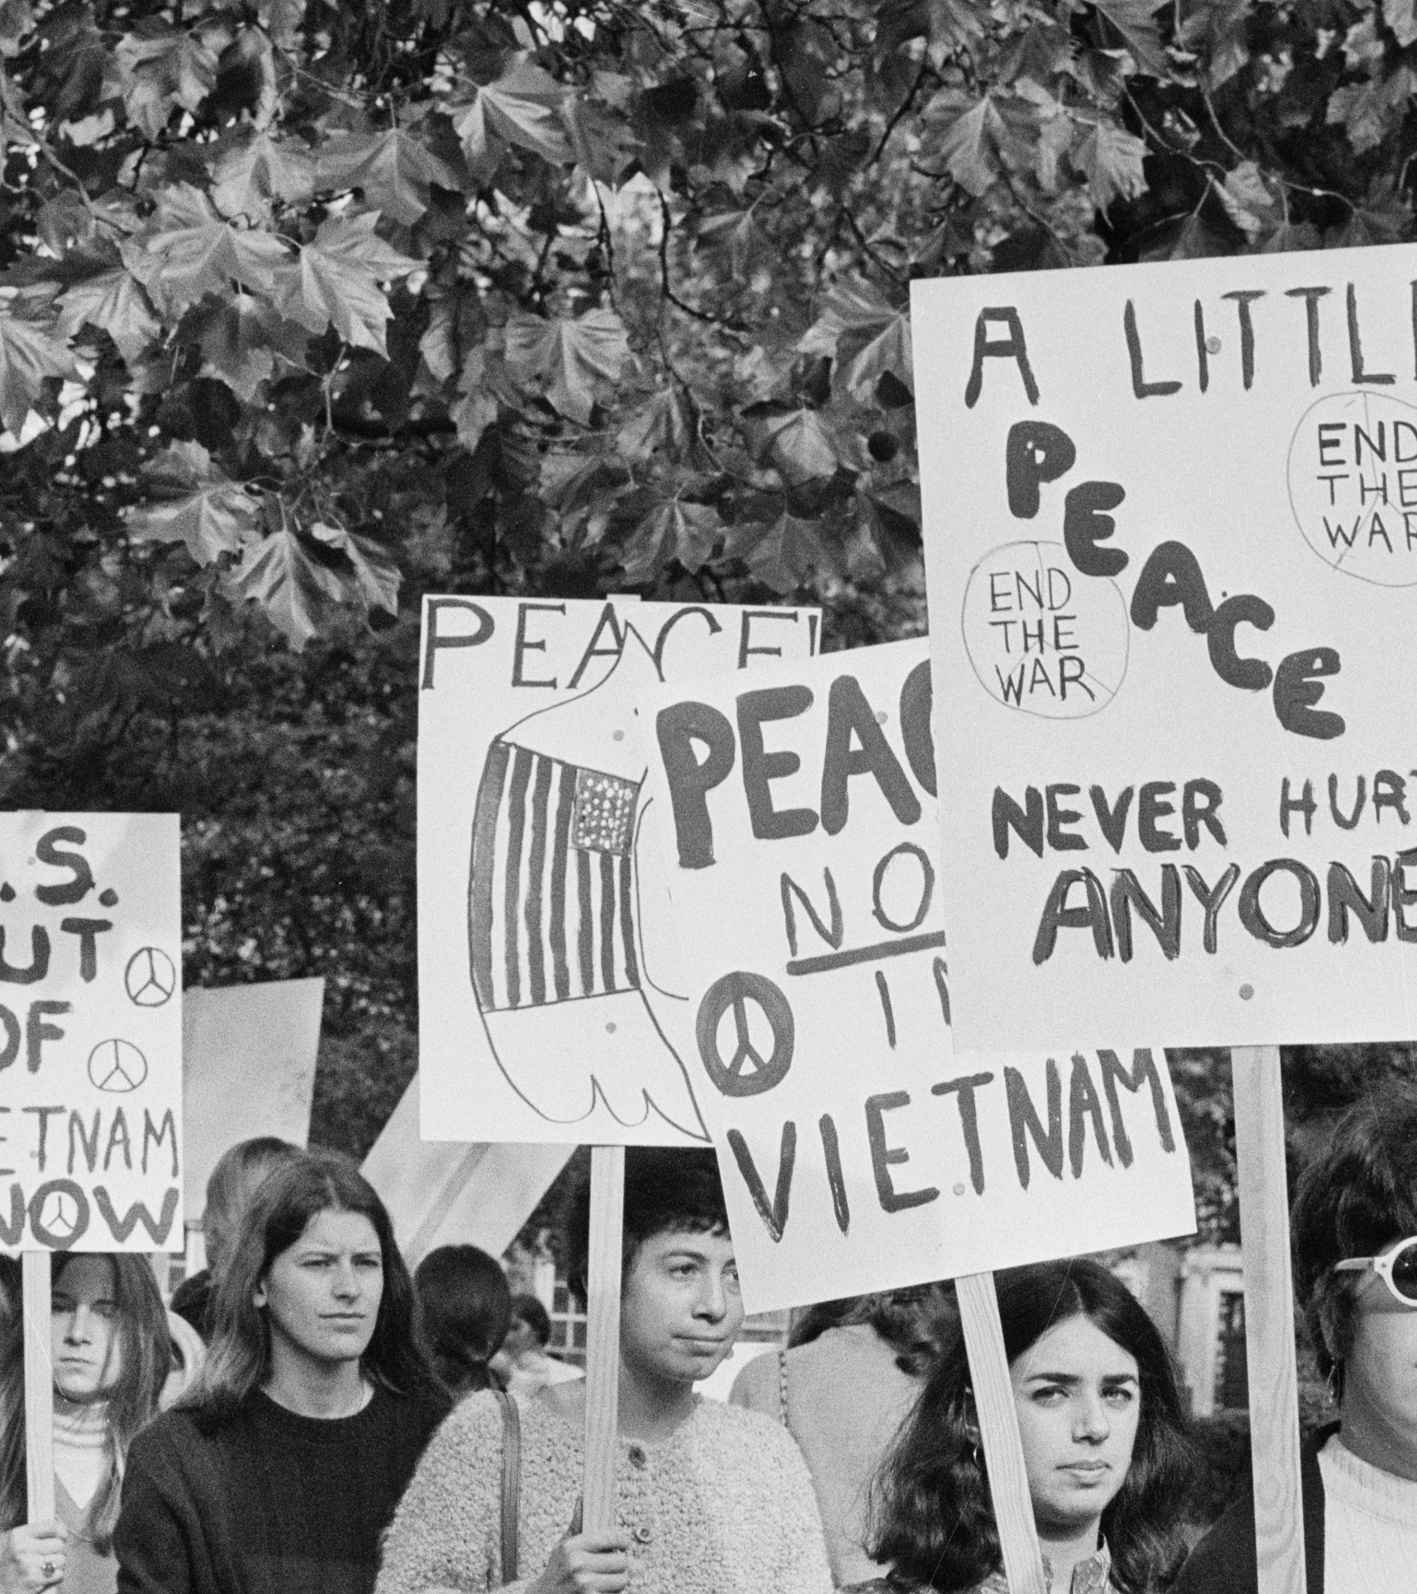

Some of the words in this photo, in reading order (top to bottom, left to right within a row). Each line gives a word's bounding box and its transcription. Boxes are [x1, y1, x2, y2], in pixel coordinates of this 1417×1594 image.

[965, 305, 1040, 409] A
[988, 567, 1072, 612] END
[1005, 419, 1347, 740] PEACE
[988, 615, 1080, 654] THE
[995, 655, 1096, 706] WAR
[992, 777, 1228, 860] NEVER
[781, 842, 935, 956] NO
[727, 1048, 1176, 1244] VIETNAM
